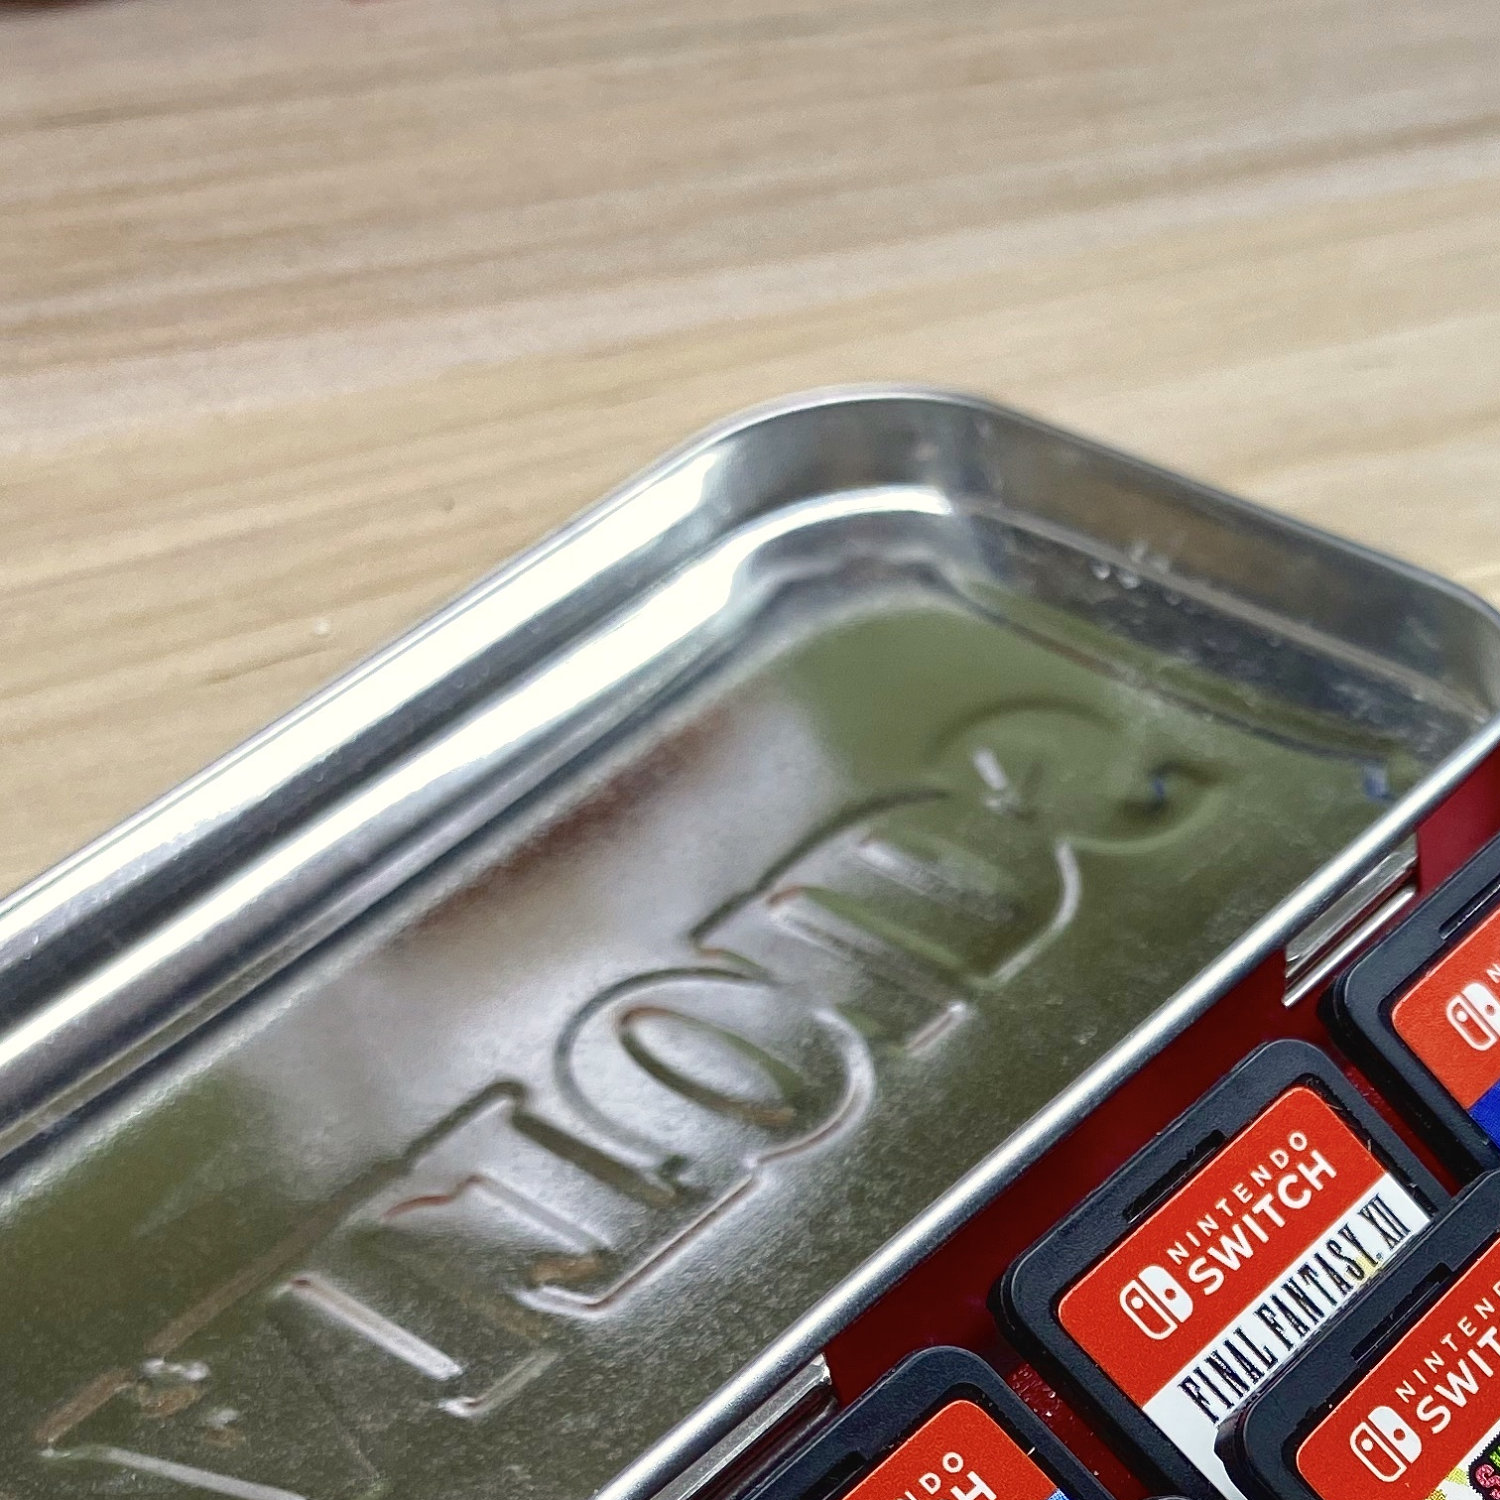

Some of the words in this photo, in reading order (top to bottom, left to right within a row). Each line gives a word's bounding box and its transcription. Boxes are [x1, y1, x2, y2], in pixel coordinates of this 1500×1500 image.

[1166, 1131, 1308, 1266] NINTENDO
[1188, 1149, 1337, 1296] SWITCH
[1178, 1326, 1279, 1424] FINAL
[1253, 1223, 1379, 1352] FANTASY
[1357, 1193, 1411, 1250] XII
